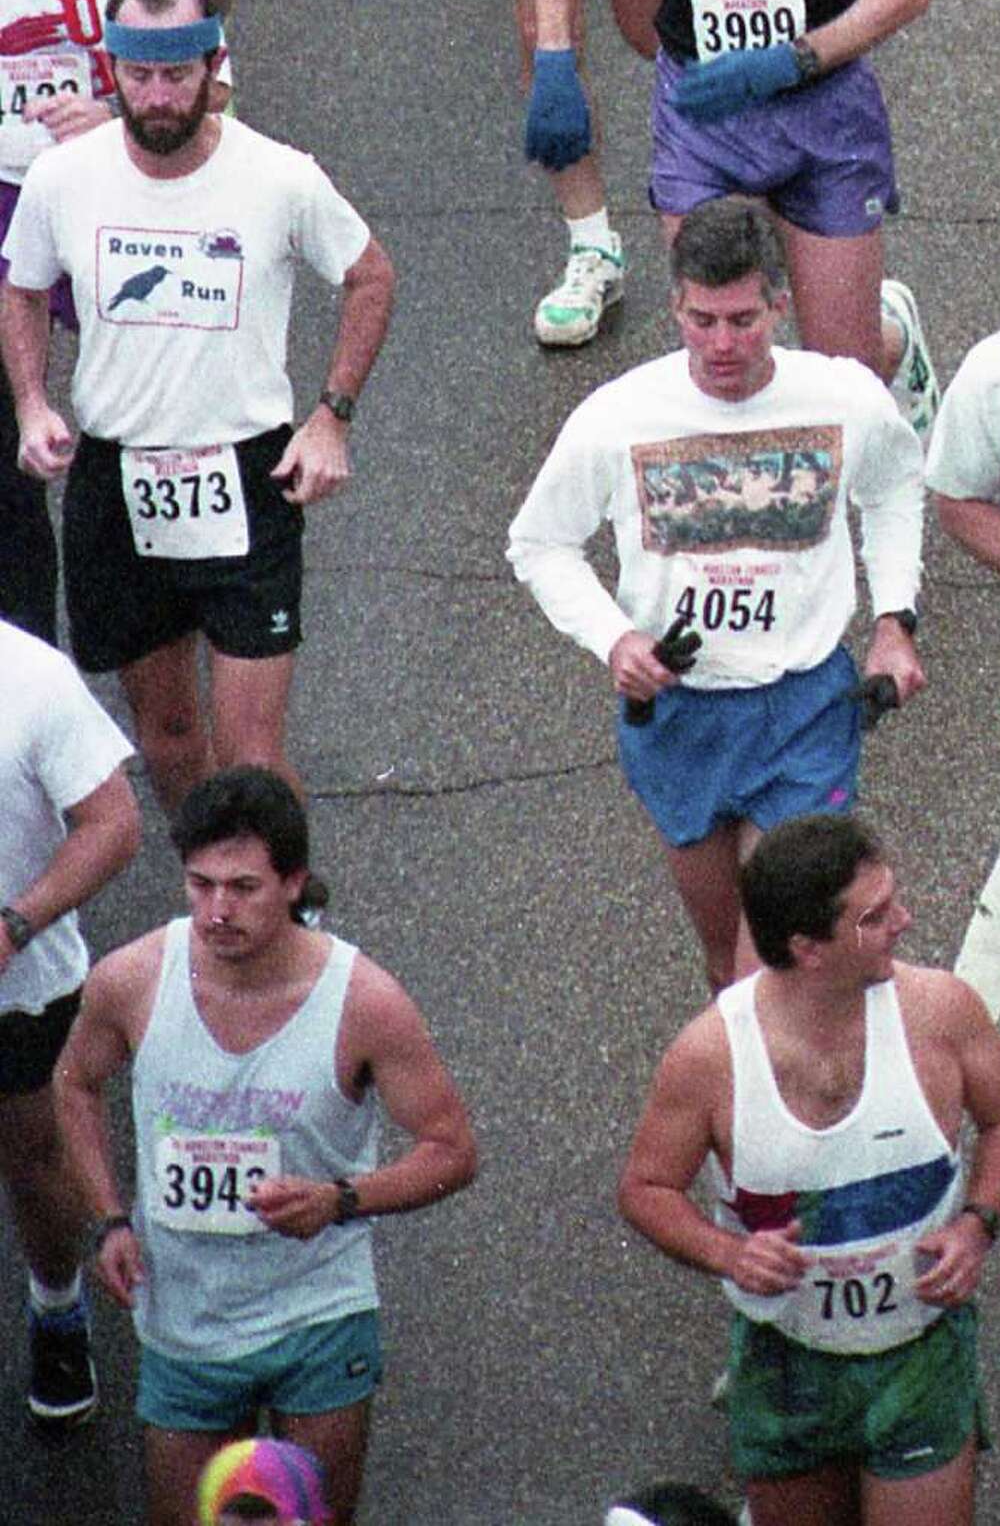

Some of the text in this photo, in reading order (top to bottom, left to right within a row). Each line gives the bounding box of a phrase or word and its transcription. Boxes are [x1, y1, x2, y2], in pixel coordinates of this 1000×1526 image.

[702, 7, 797, 52] 3999
[109, 236, 183, 258] Raven
[181, 279, 226, 302] Run
[133, 471, 232, 521] 3373
[675, 585, 776, 632] 4054
[812, 1271, 898, 1321] 702
